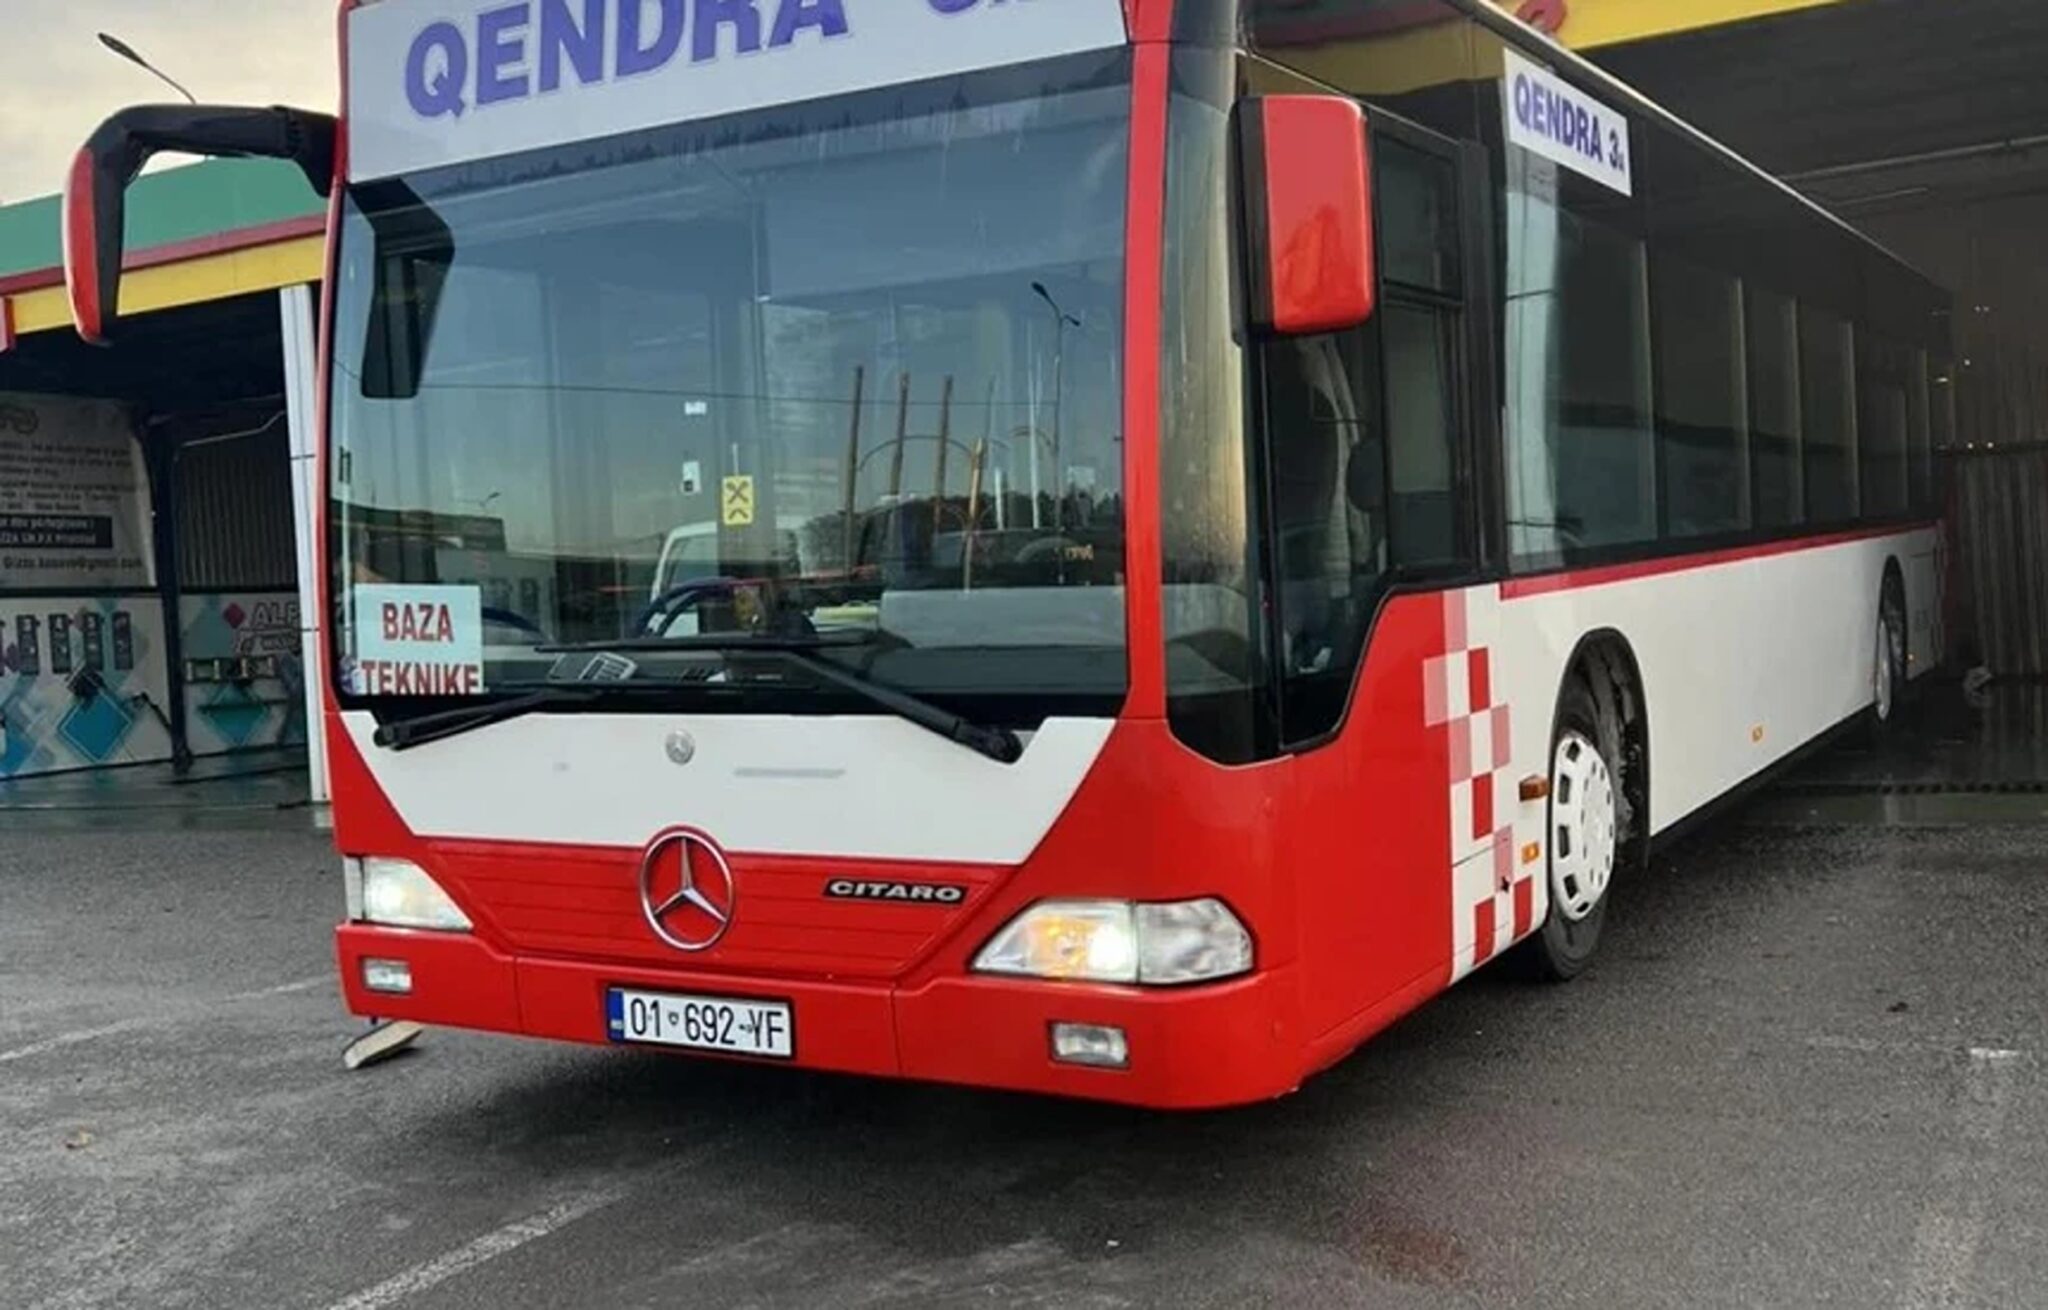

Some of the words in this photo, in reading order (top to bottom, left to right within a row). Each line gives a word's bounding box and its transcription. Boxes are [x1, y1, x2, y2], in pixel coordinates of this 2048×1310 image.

[1514, 73, 1603, 162] QENDRA
[382, 602, 455, 642] BAZA
[361, 661, 480, 694] TEKNIKE
[830, 881, 962, 901] CITARO
